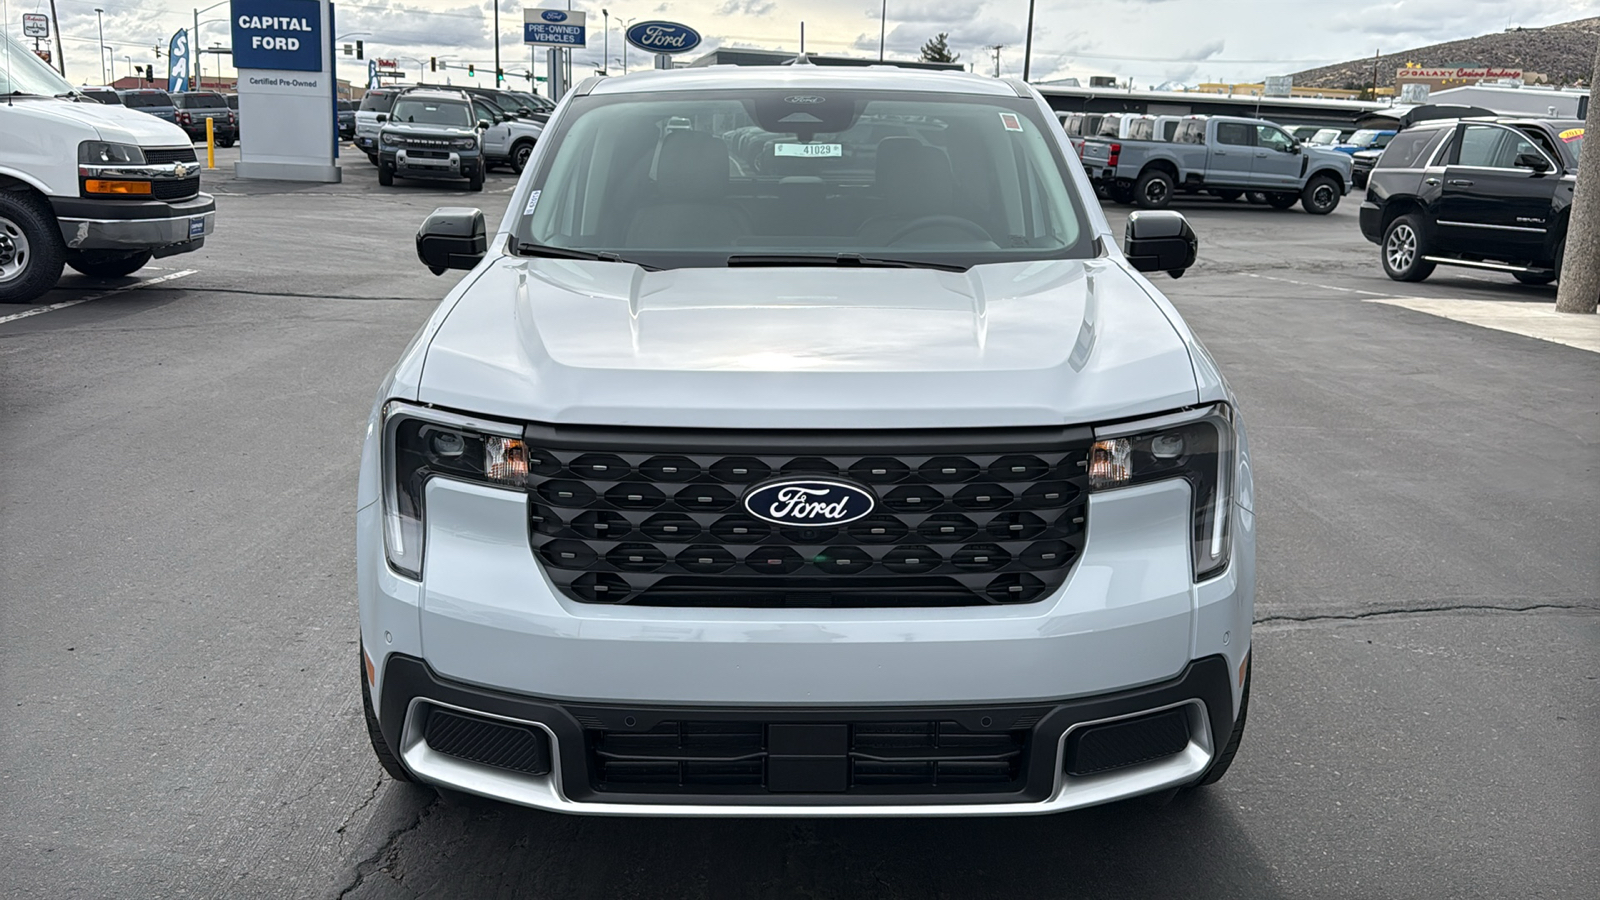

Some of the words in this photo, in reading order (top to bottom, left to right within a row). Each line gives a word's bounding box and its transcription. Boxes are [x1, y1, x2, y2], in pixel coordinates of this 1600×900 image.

[546, 12, 562, 20] Ford
[238, 15, 312, 31] CAPITAL
[528, 24, 580, 35] PRE-OWNED
[534, 33, 575, 43] VEHICLES
[641, 25, 687, 47] Ford
[252, 36, 300, 51] FORD
[1456, 68, 1485, 78] Casino
[249, 77, 278, 86] Certified
[279, 79, 317, 88] Pre-Owned
[791, 95, 818, 103] Ford
[803, 145, 831, 155] 41029
[769, 486, 850, 519] Ford
